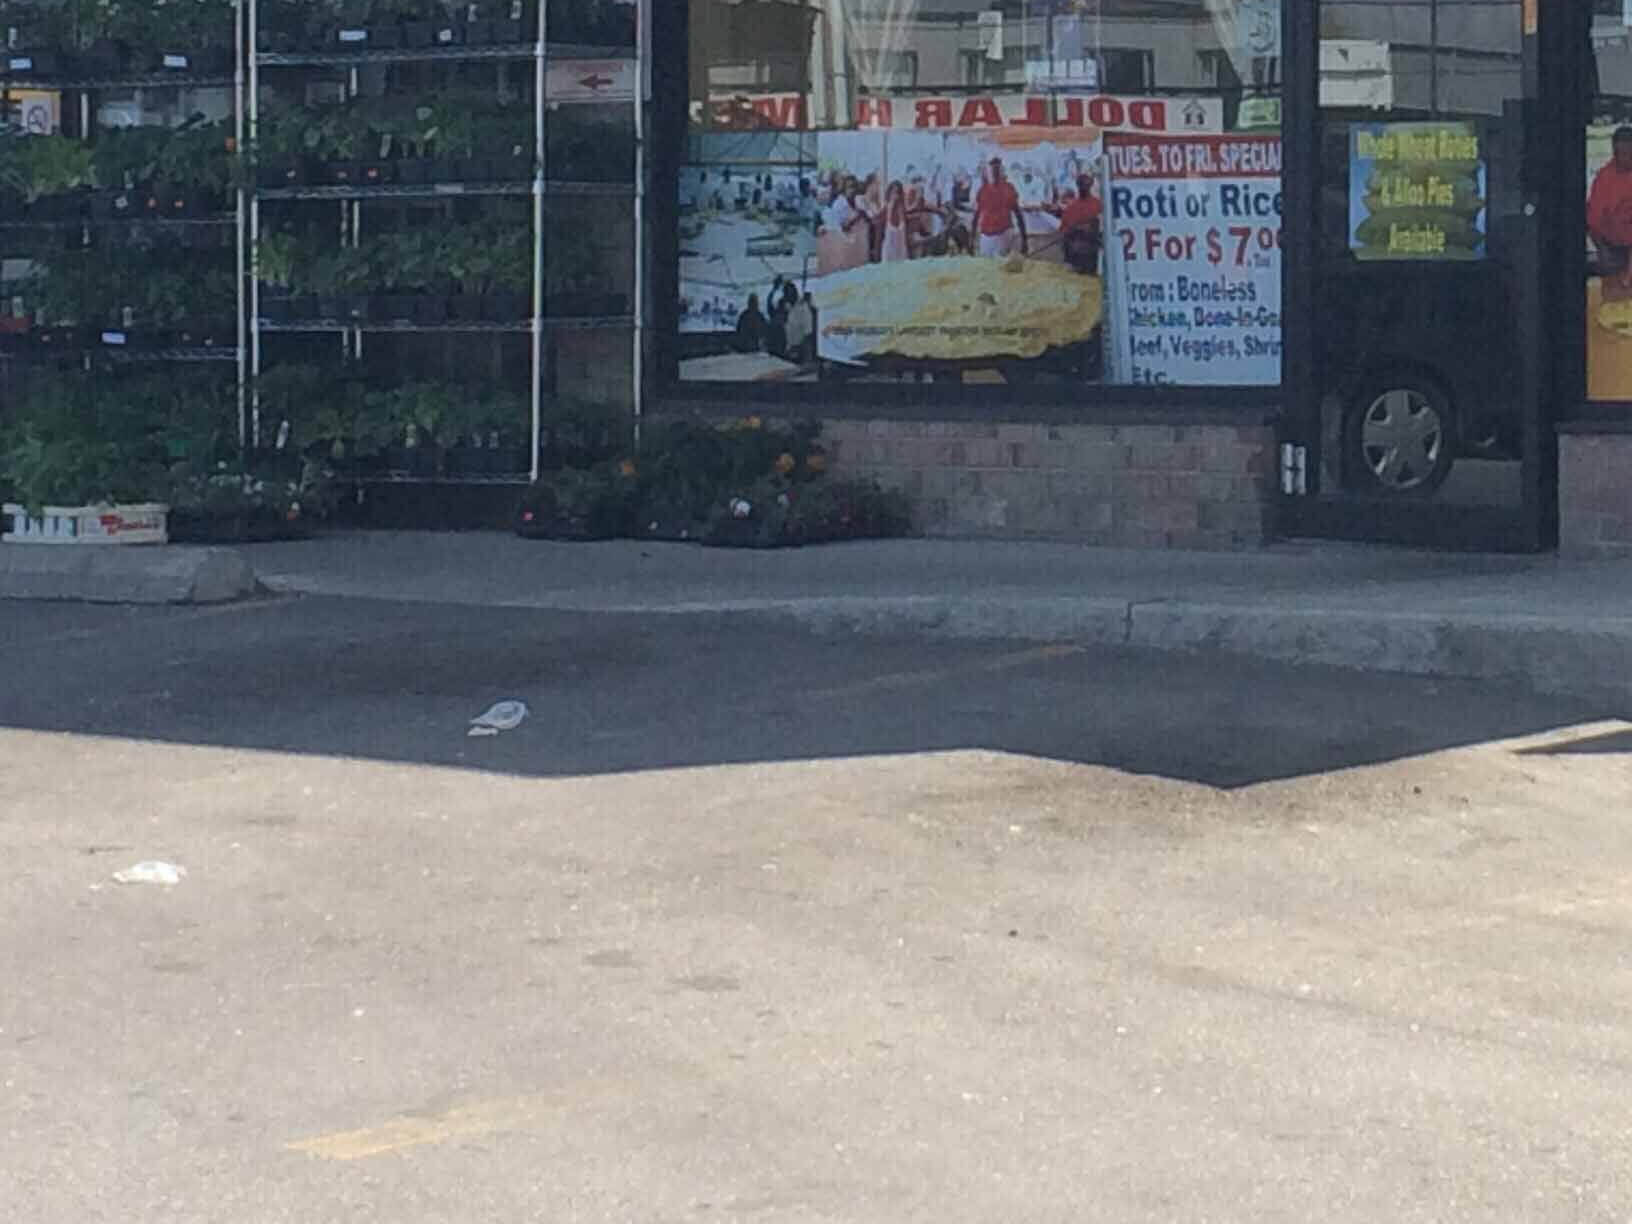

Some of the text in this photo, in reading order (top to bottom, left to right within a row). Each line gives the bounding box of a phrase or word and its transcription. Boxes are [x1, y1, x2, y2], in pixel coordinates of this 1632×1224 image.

[1107, 144, 1157, 175] TUES.
[1158, 143, 1184, 173] TO
[1110, 184, 1178, 219] Roti
[1185, 192, 1211, 218] or
[1118, 227, 1137, 263] 2
[1145, 227, 1198, 262] For
[1176, 274, 1257, 302] Boneless
